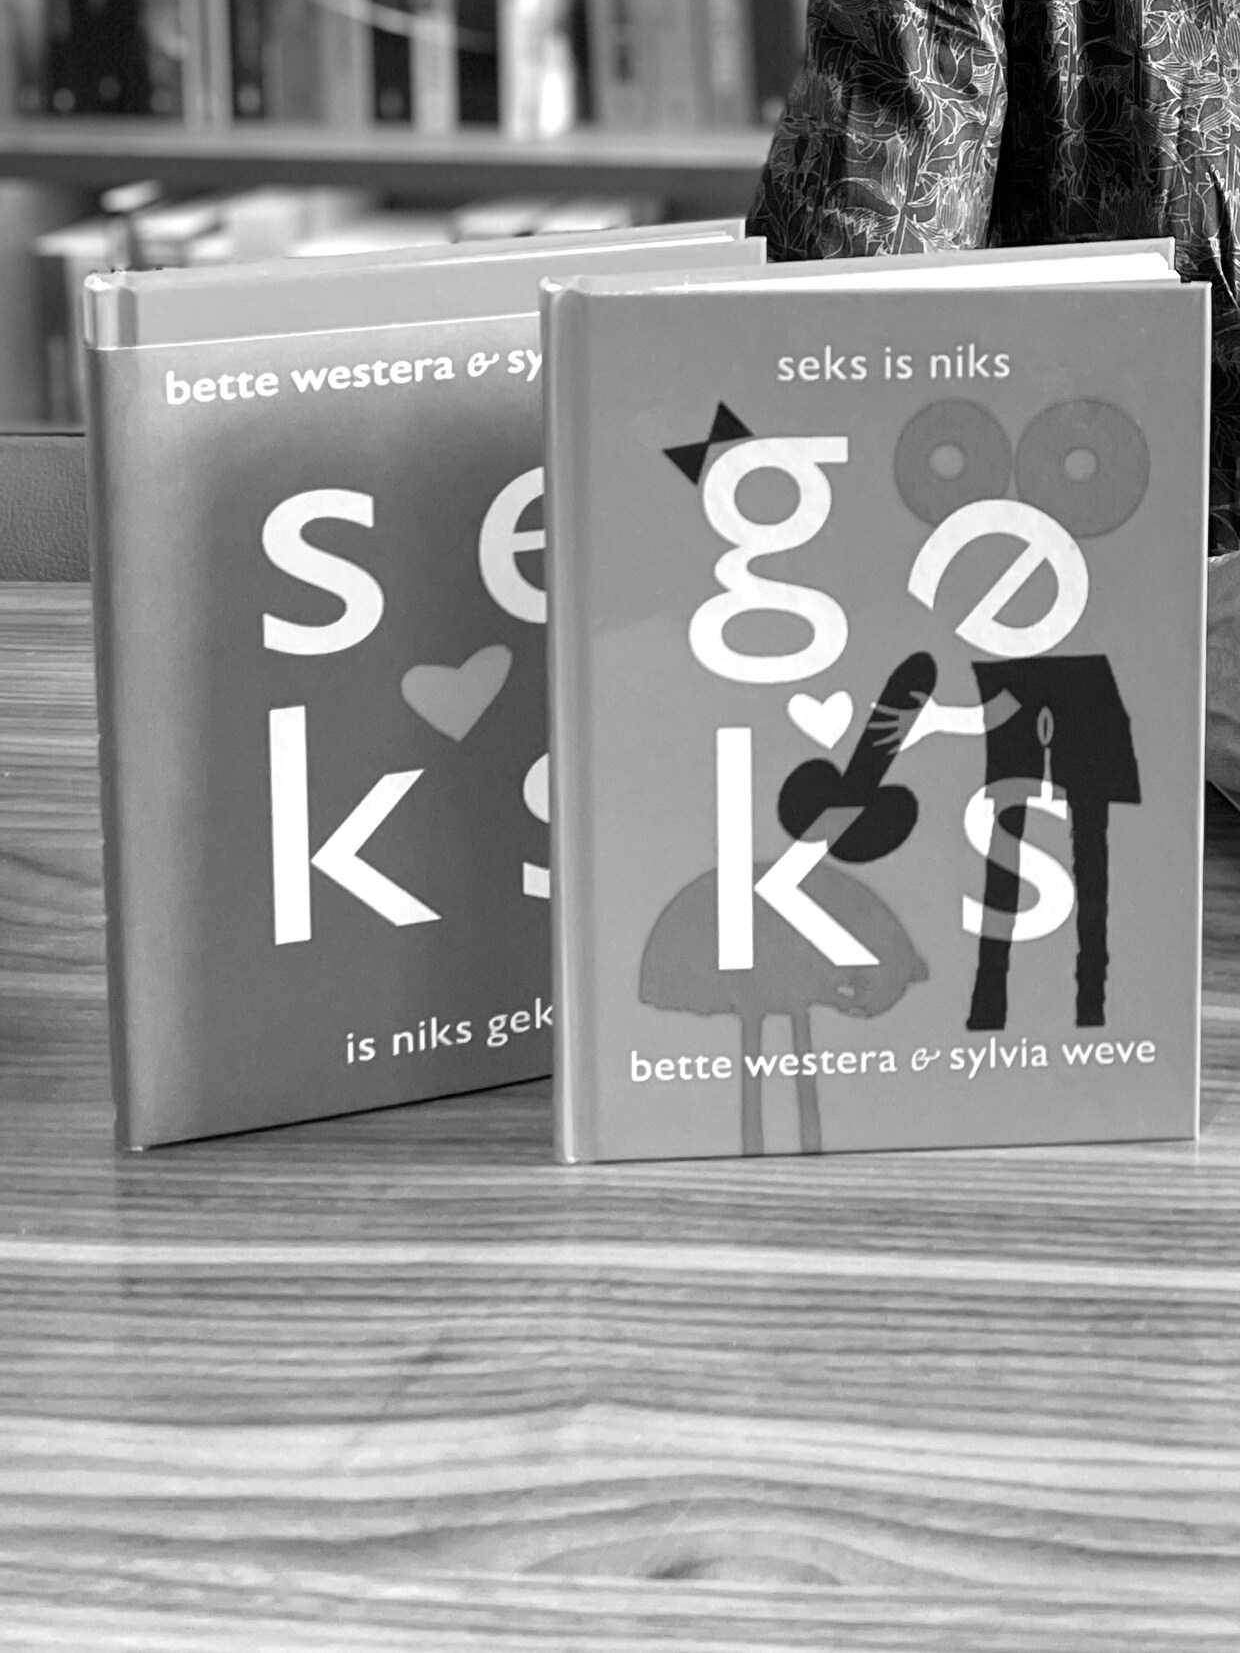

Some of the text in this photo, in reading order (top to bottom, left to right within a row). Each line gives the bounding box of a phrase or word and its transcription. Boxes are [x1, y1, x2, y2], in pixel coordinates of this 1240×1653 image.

[165, 370, 280, 406] bette
[289, 355, 456, 394] westera
[777, 343, 1012, 382] seks is niks
[346, 1032, 377, 1065] is
[392, 1016, 473, 1057] niks
[629, 1049, 733, 1084] bette
[744, 1049, 899, 1078] westera
[948, 1035, 1049, 1081] sylvia
[1061, 1040, 1158, 1066] weve
